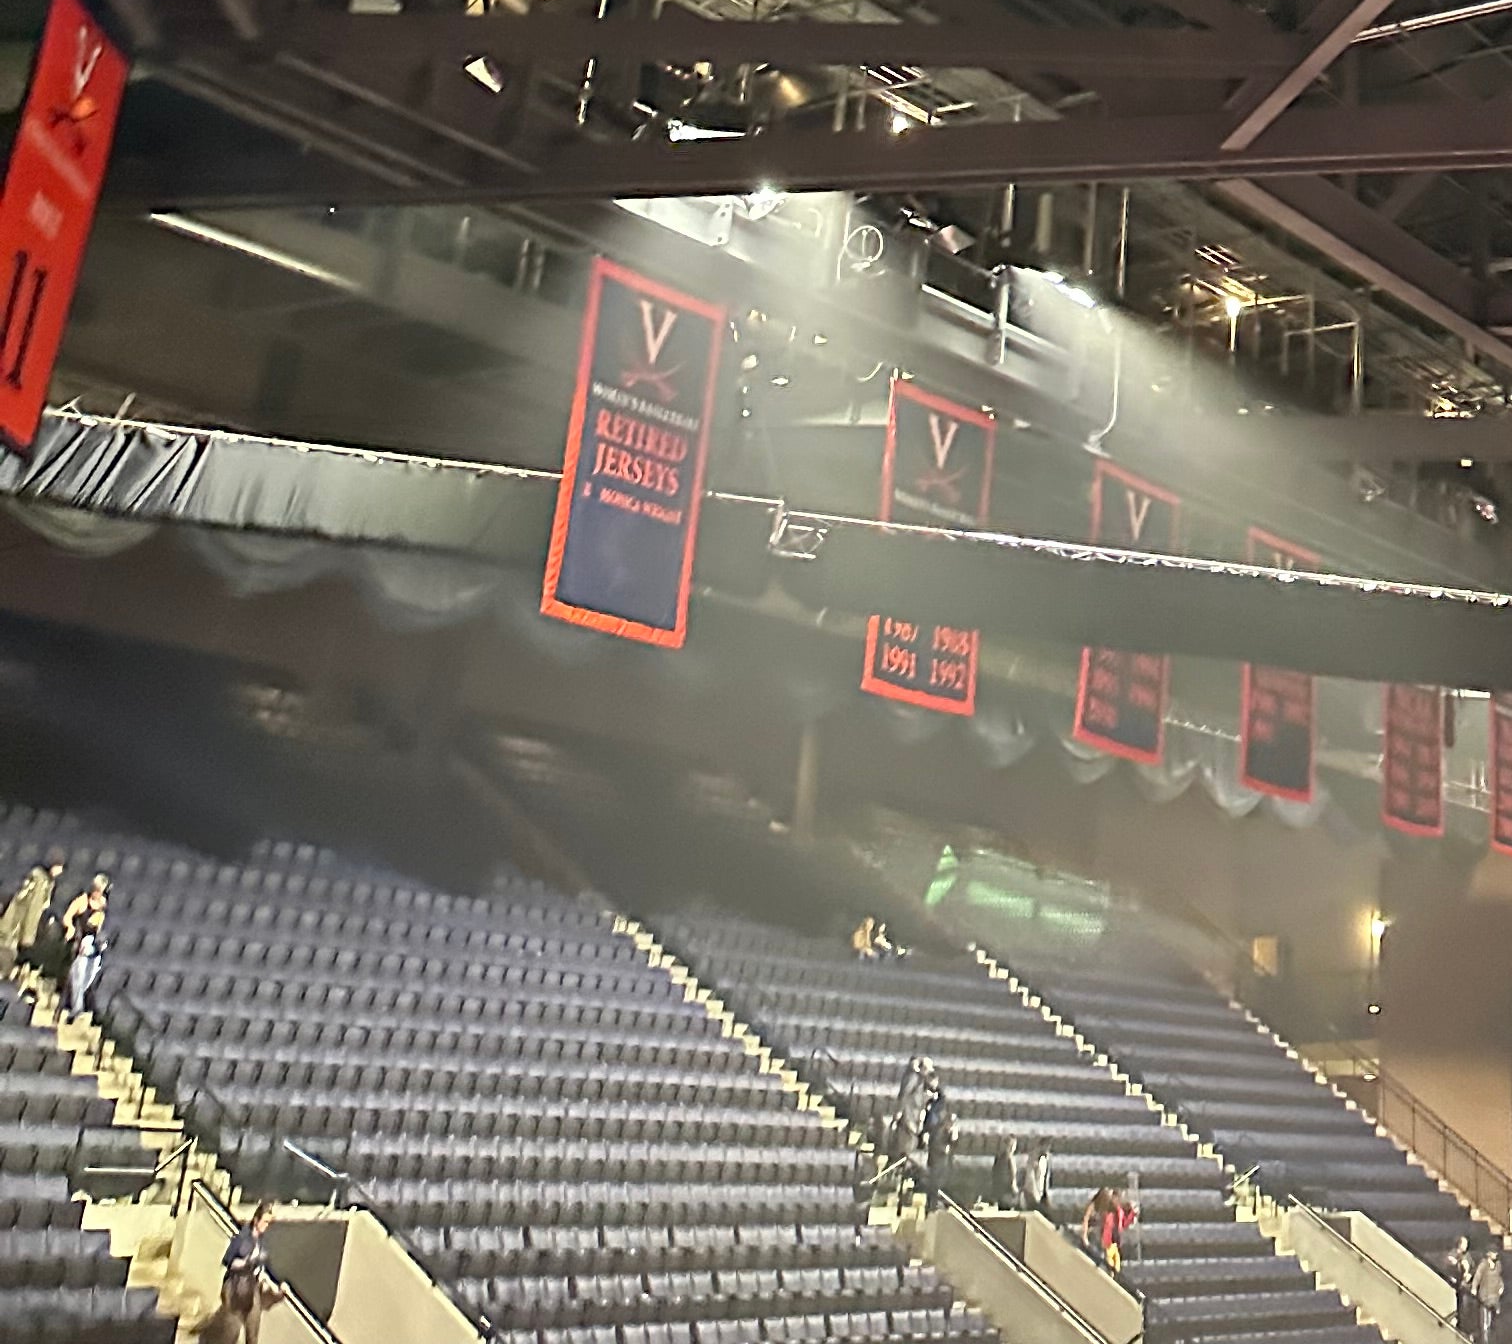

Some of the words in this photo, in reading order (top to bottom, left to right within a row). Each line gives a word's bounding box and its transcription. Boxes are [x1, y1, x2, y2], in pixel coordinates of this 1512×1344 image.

[596, 408, 687, 463] RETIRED
[592, 442, 680, 497] JERSEYS
[881, 642, 916, 679] 1991
